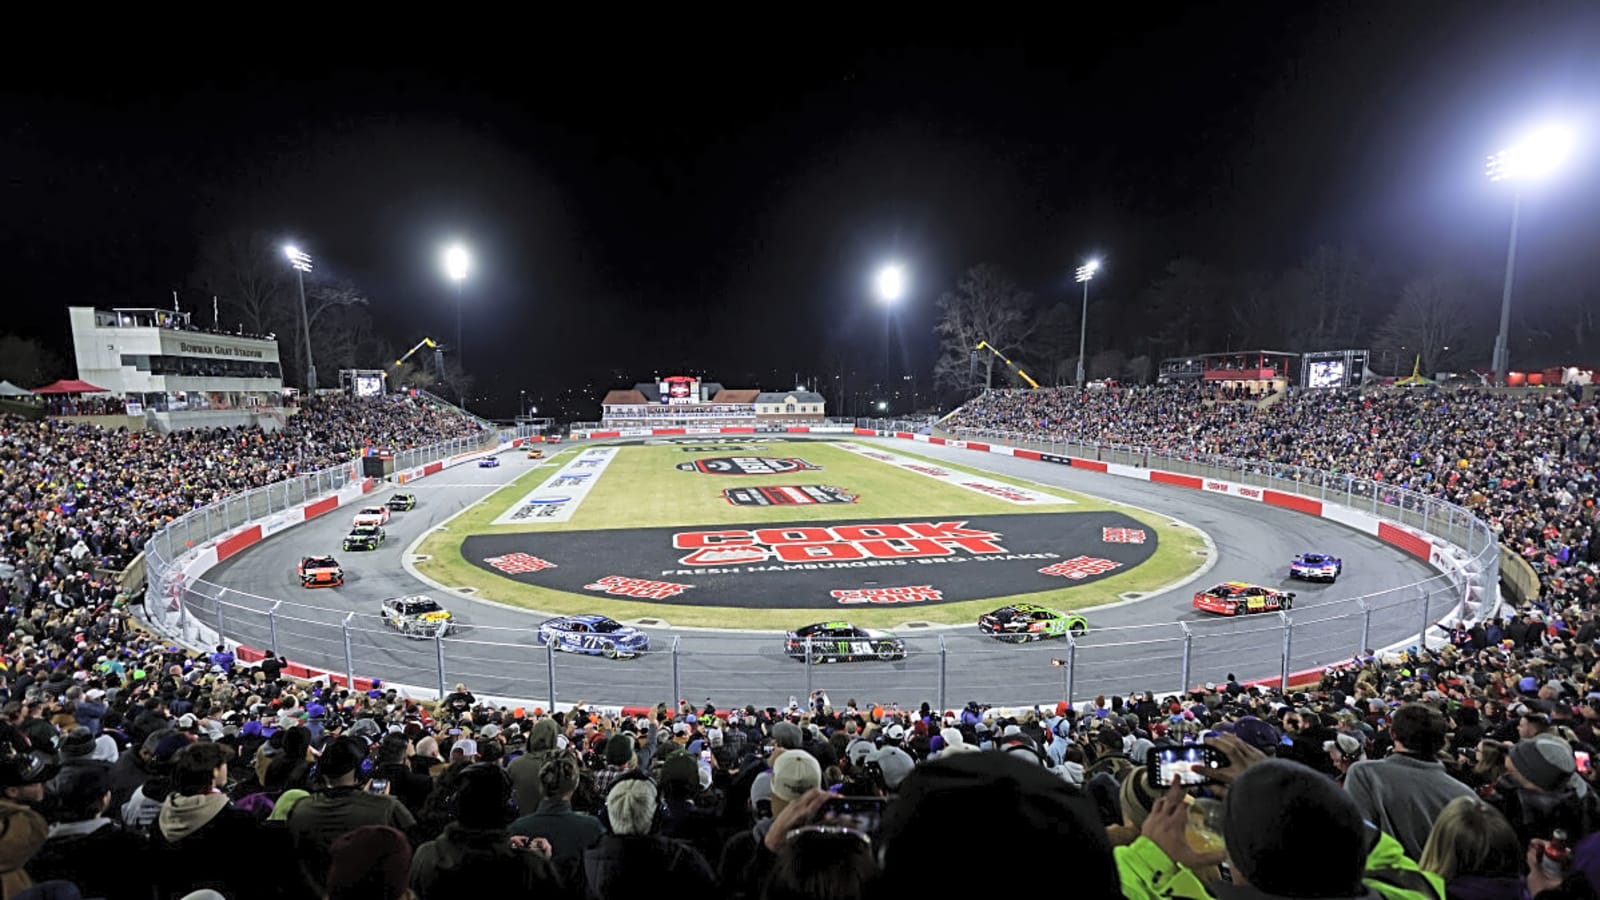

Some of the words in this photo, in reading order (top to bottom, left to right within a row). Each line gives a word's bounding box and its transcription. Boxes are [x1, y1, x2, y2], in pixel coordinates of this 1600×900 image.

[673, 521, 1003, 549] COOK
[771, 536, 1009, 562] OUT
[661, 567, 740, 576] FRESH
[747, 558, 908, 572] HAMBURGERS
[971, 552, 1061, 562] SHAKES
[584, 635, 599, 648] 71
[850, 641, 875, 654] 54
